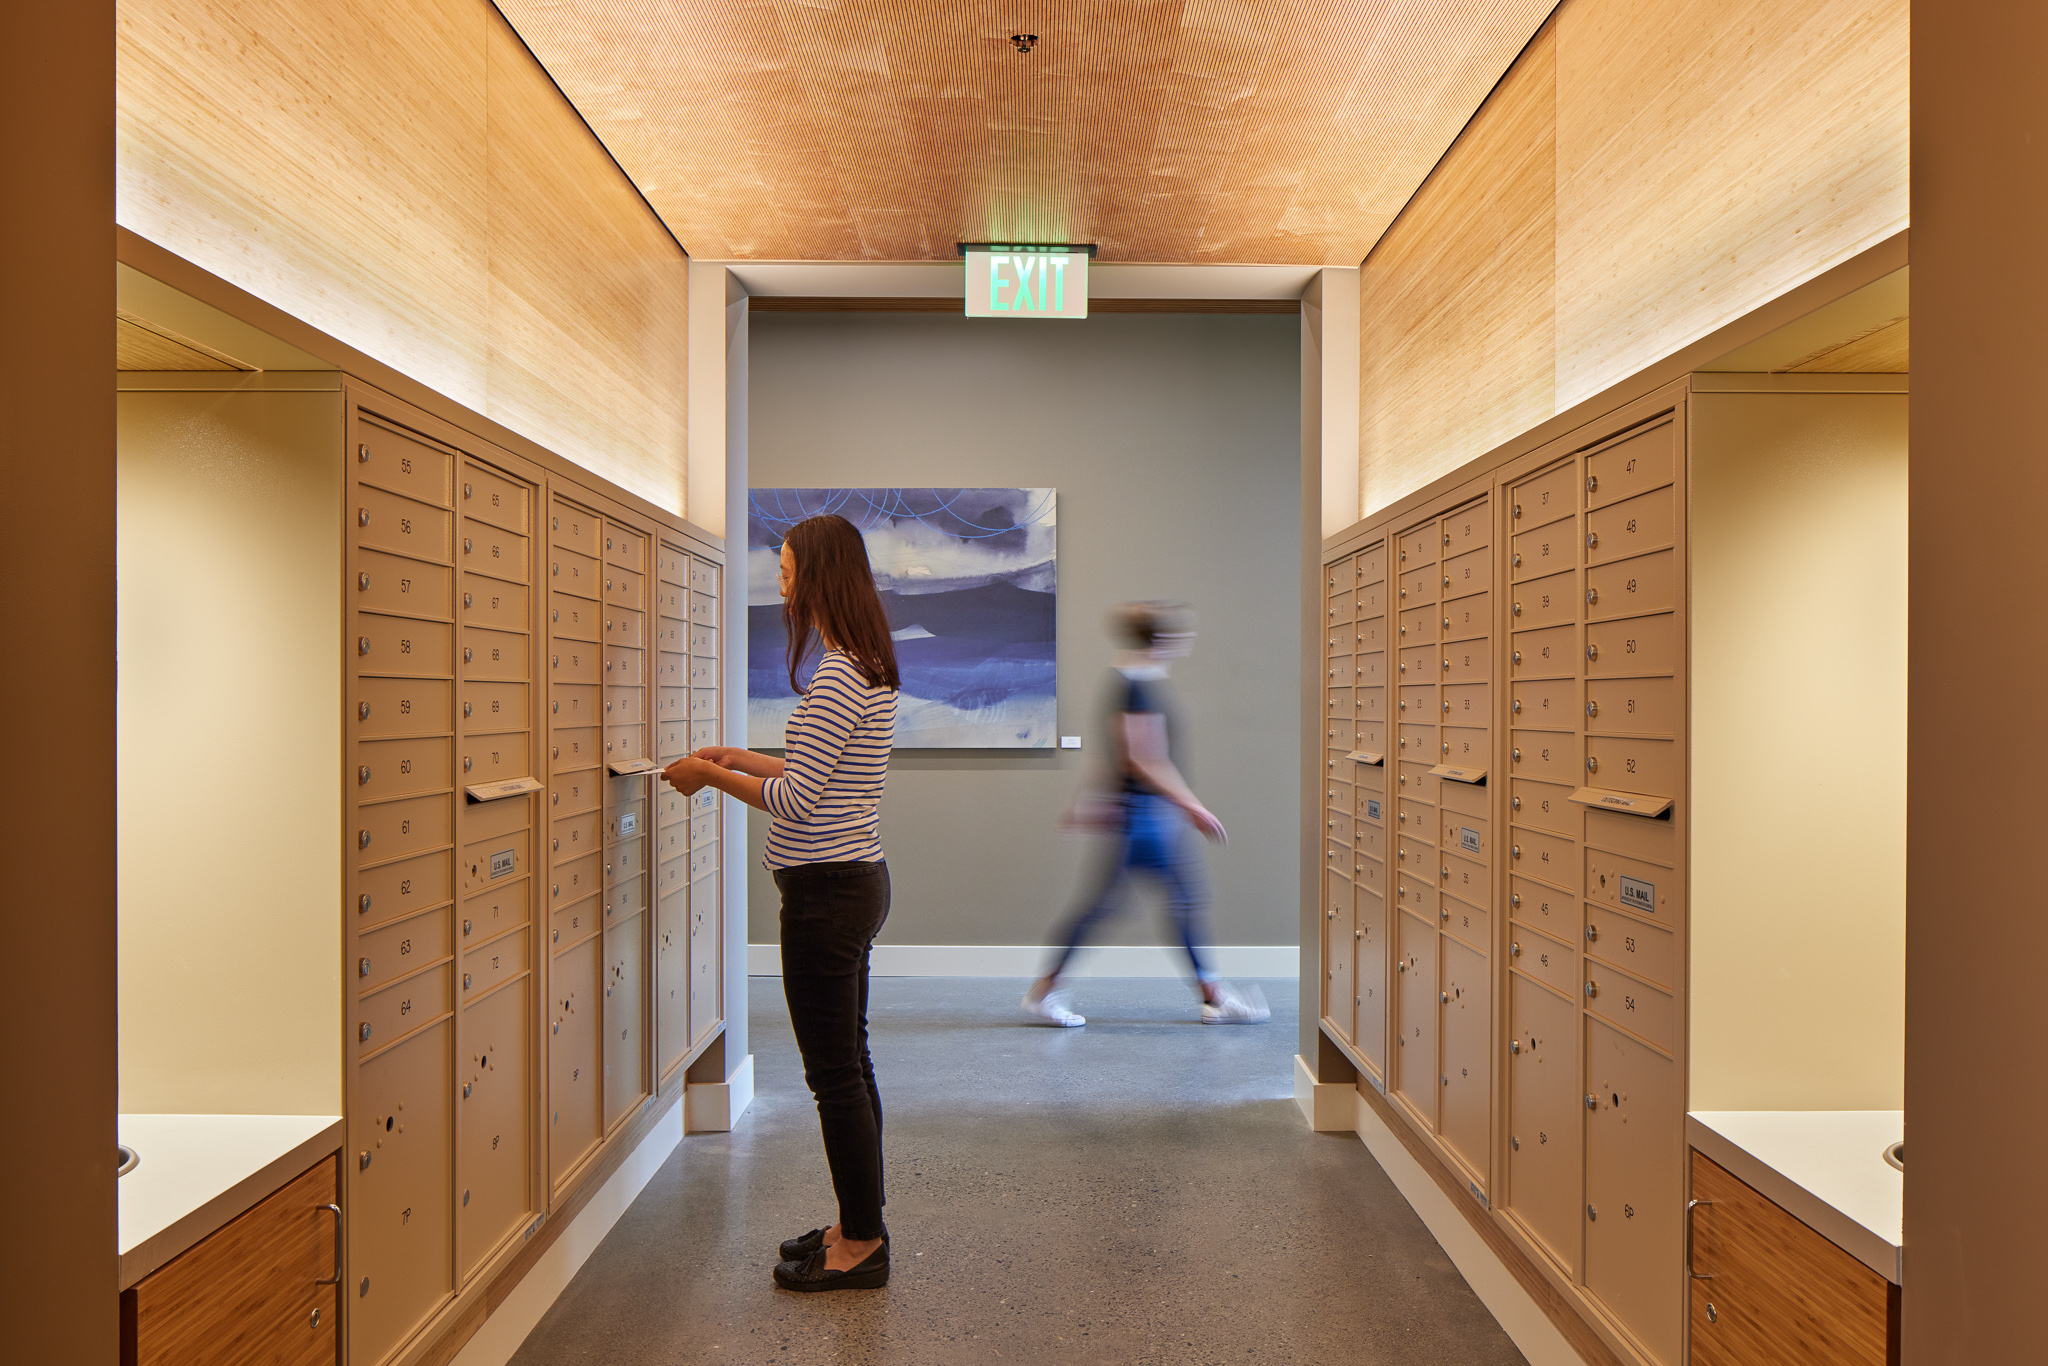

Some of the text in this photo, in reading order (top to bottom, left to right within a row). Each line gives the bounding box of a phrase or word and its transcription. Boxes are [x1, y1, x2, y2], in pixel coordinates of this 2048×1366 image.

[989, 255, 1070, 311] EXIT
[401, 458, 412, 475] 55
[1626, 458, 1636, 475] 47
[491, 493, 500, 508] 65
[1541, 491, 1550, 506] 37
[400, 518, 412, 535] 56
[1626, 518, 1637, 534] 48
[491, 545, 500, 559] 66
[1541, 543, 1550, 557] 38
[400, 578, 411, 594] 57
[1626, 578, 1637, 594] 49
[491, 596, 500, 610] 67
[1542, 595, 1550, 609] 39
[400, 639, 411, 654] 58
[1541, 646, 1550, 659] 40
[1626, 639, 1637, 654] 50
[491, 648, 500, 662] 68
[400, 699, 411, 715] 59
[491, 700, 500, 713] 69
[1542, 698, 1549, 710] 41
[1627, 699, 1635, 714] 51
[491, 751, 500, 765] 70
[1541, 748, 1550, 762] 42
[400, 759, 412, 775] 60
[1626, 758, 1636, 774] 52
[1541, 800, 1550, 813] 43
[401, 819, 410, 835] 61
[502, 857, 512, 867] MAIL
[1541, 851, 1550, 865] 44
[400, 879, 411, 896] 62
[1625, 885, 1636, 898] U.S.
[1636, 889, 1650, 902] MAIL
[492, 905, 499, 919] 71
[1540, 902, 1549, 916] 45
[400, 939, 411, 956] 63
[1625, 936, 1636, 953] 53
[491, 956, 500, 970] 72
[1540, 953, 1549, 968] 46
[400, 998, 412, 1016] 64
[1625, 995, 1635, 1013] 54
[401, 1207, 412, 1226] 7P
[1624, 1203, 1635, 1220] 6P
